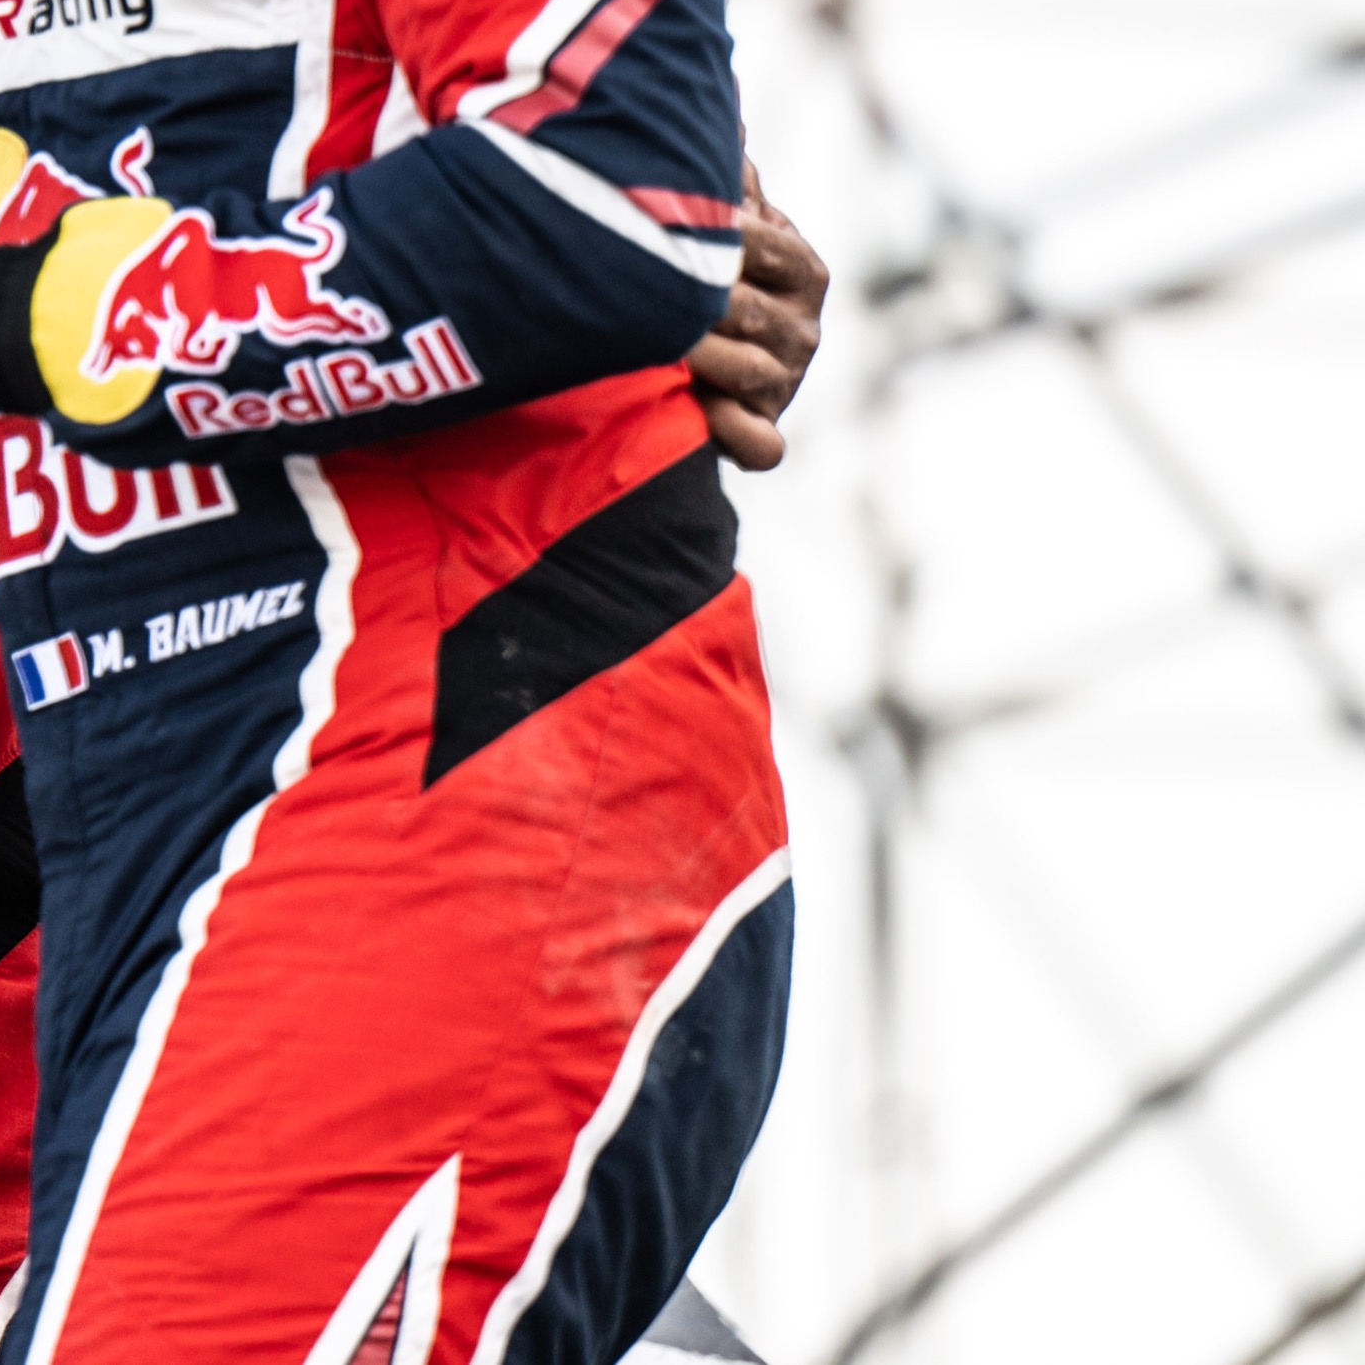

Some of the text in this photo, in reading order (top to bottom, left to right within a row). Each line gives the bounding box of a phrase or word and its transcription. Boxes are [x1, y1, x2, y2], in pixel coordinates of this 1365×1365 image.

[171, 322, 476, 436] Red Bull
[87, 628, 137, 678] M.
